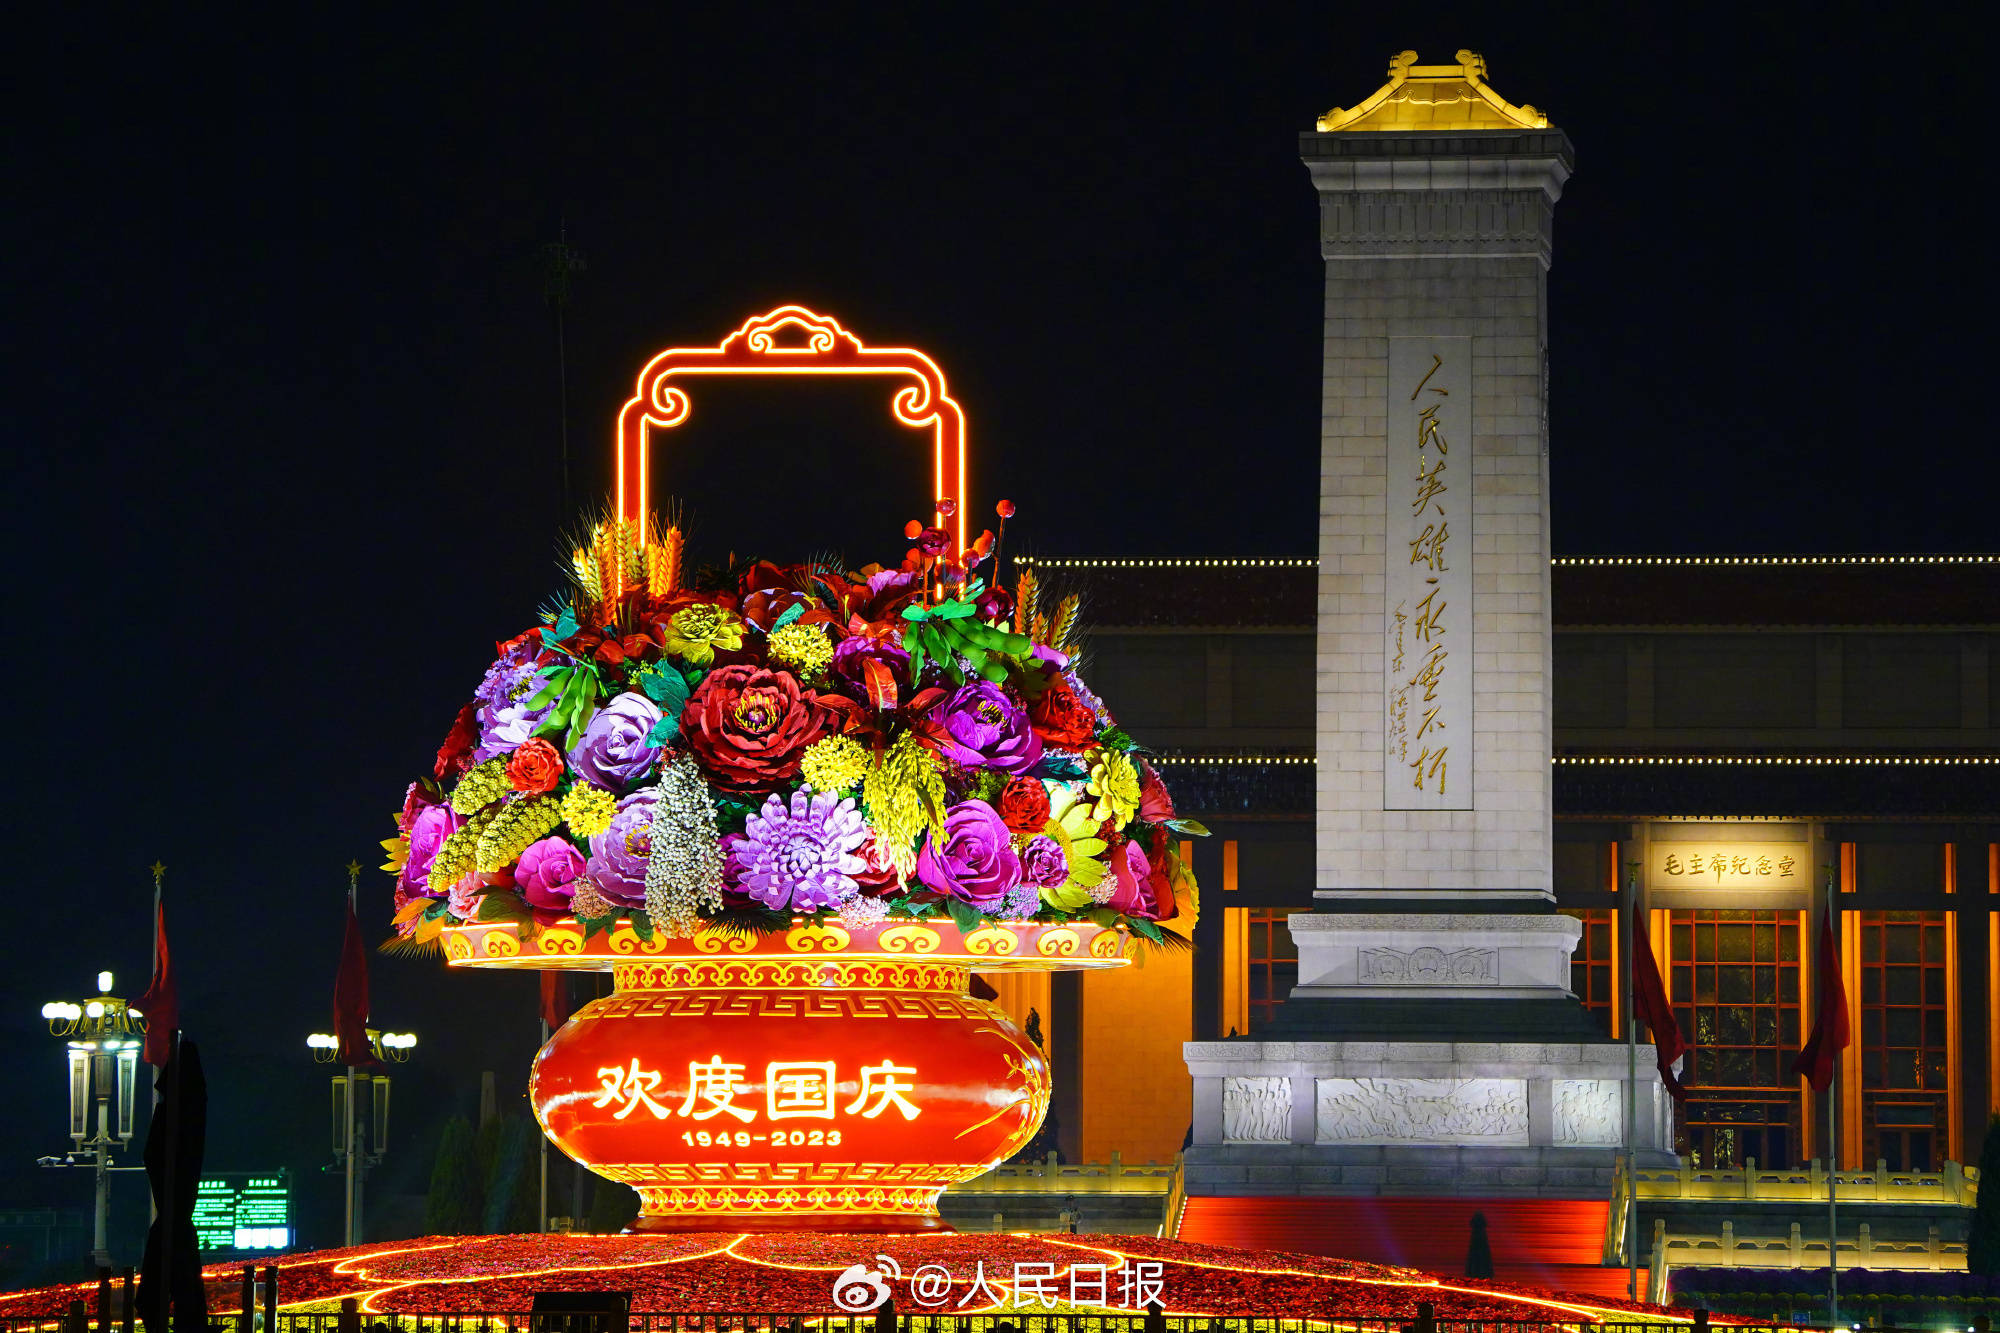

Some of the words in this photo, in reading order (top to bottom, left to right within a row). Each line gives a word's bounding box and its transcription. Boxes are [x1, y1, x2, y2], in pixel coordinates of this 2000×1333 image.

[1409, 354, 1449, 795] 人民英雄永垂不朽
[1663, 853, 1795, 884] 毛主席纪念堂
[592, 1055, 923, 1123] 欢度国庆
[681, 1131, 842, 1147] 1949-2023
